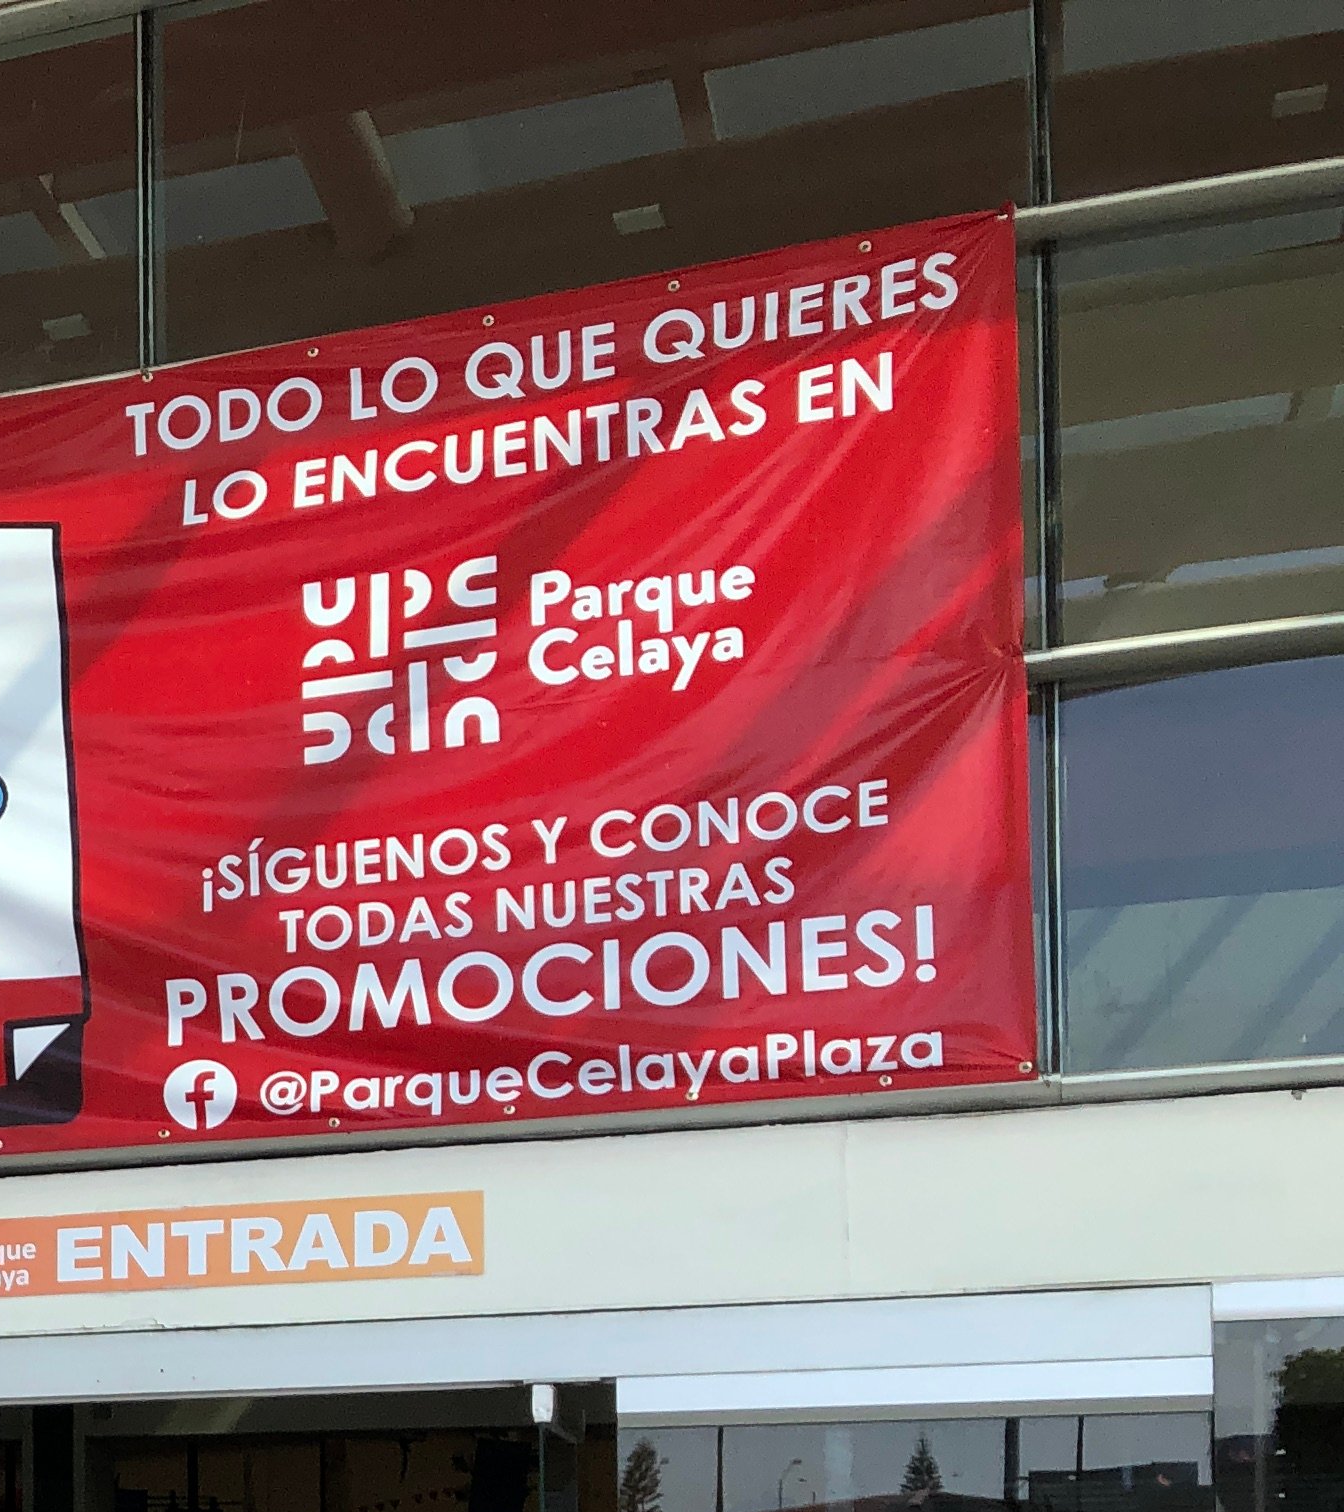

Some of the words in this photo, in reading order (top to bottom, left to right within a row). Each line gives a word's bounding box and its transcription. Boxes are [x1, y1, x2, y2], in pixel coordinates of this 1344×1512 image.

[126, 375, 322, 456] TODO
[350, 357, 438, 420] LO
[465, 322, 615, 399] QUE
[643, 253, 958, 364] QUIERES
[183, 471, 267, 525] LO
[293, 378, 766, 508] ENCUENTRAS
[798, 352, 892, 423] EN
[531, 564, 755, 628] Parque
[528, 622, 743, 691] Celaya
[202, 822, 510, 912] ¡SÍGUENOS
[531, 818, 567, 864] Y
[590, 779, 888, 857] CONOCE
[280, 894, 474, 953] TODAS
[495, 857, 794, 934] NUESTRAS
[167, 903, 937, 1047] PROMOCIONES!
[259, 1029, 944, 1115] @ParqueCelayaPlaza
[58, 1207, 472, 1281] ENTRADA
